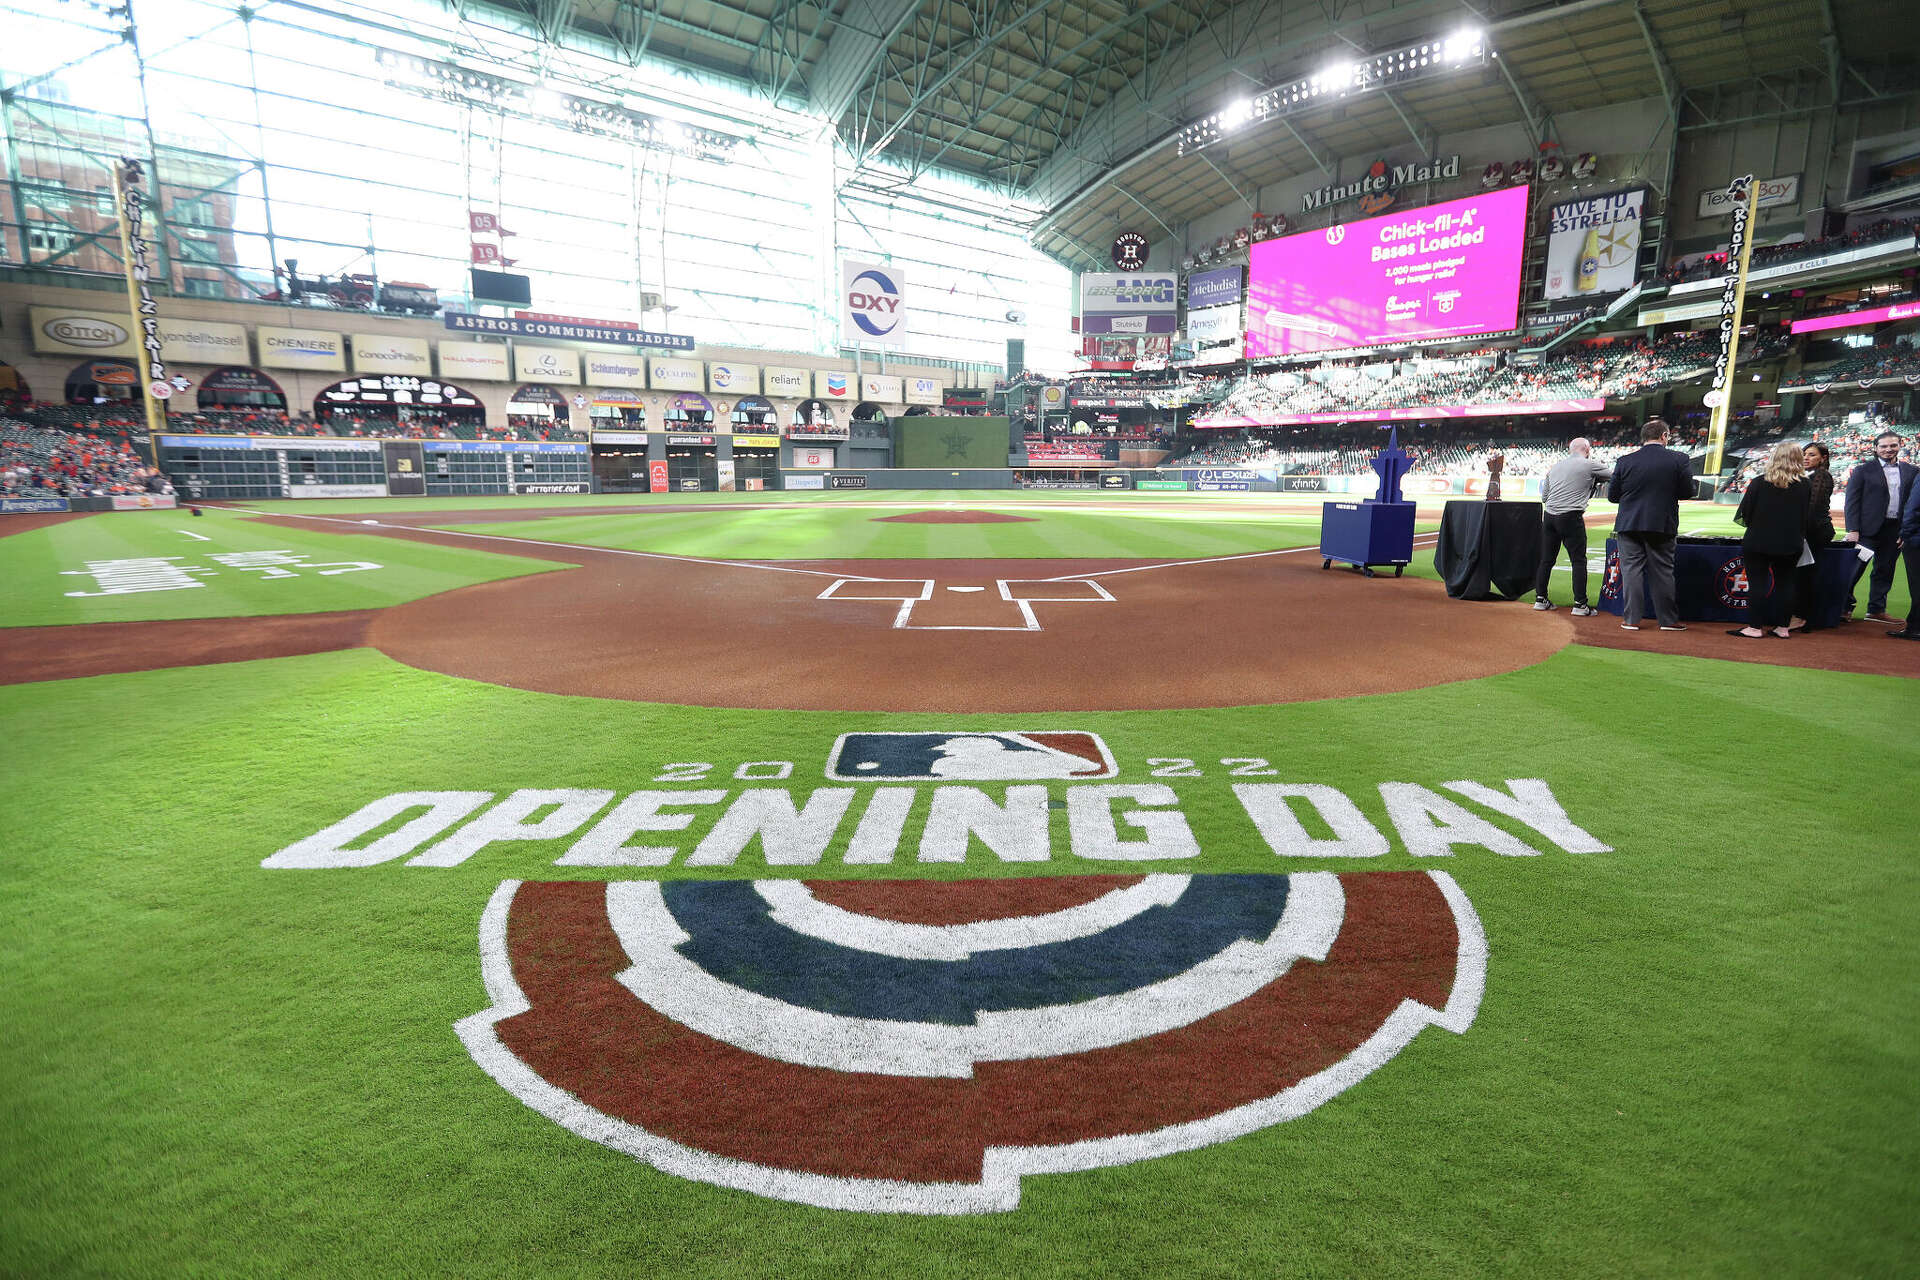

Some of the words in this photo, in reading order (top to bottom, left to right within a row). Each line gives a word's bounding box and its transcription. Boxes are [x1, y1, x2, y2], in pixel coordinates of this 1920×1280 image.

[1302, 174, 1386, 213] Minute
[1391, 155, 1459, 186] Maid
[1758, 182, 1793, 198] Bay
[1601, 193, 1628, 211] TU
[474, 216, 492, 228] 05
[1116, 233, 1146, 246] HOUSTON
[1731, 208, 1748, 256] ROOT
[1371, 242, 1416, 262] Bases
[1419, 225, 1485, 254] Loaded
[478, 247, 494, 259] 19
[1123, 245, 1138, 259] H
[1432, 255, 1466, 272] pledged
[1726, 260, 1739, 273] 4
[1805, 257, 1829, 269] CLUB
[1192, 277, 1238, 297] Methodist
[1395, 276, 1406, 286] for
[1087, 285, 1164, 297] FREEPORT
[1116, 278, 1175, 303] LNG
[1723, 279, 1739, 315] THA
[848, 292, 900, 313] OXY
[1537, 315, 1554, 324] MLB
[54, 322, 117, 344] COTTON
[455, 316, 518, 331] ASTROS
[525, 322, 621, 341] COMMUNITY
[627, 332, 688, 347] LEADERS
[142, 317, 165, 380] FAIR
[266, 336, 336, 350] CHENIERE
[358, 349, 425, 364] ConocoPhillips
[1712, 319, 1733, 389] CHIKIN
[523, 367, 573, 377] LEXUS
[590, 362, 640, 377] Schlumberger
[713, 373, 732, 381] OXY
[770, 374, 801, 386] reliant
[1077, 399, 1107, 408] impact
[1114, 399, 1144, 408] impact
[1291, 478, 1321, 490] xfinity
[652, 760, 793, 782] 20
[1145, 756, 1281, 778] 22
[260, 783, 1202, 869] OPENING
[1231, 777, 1615, 859] DAY
